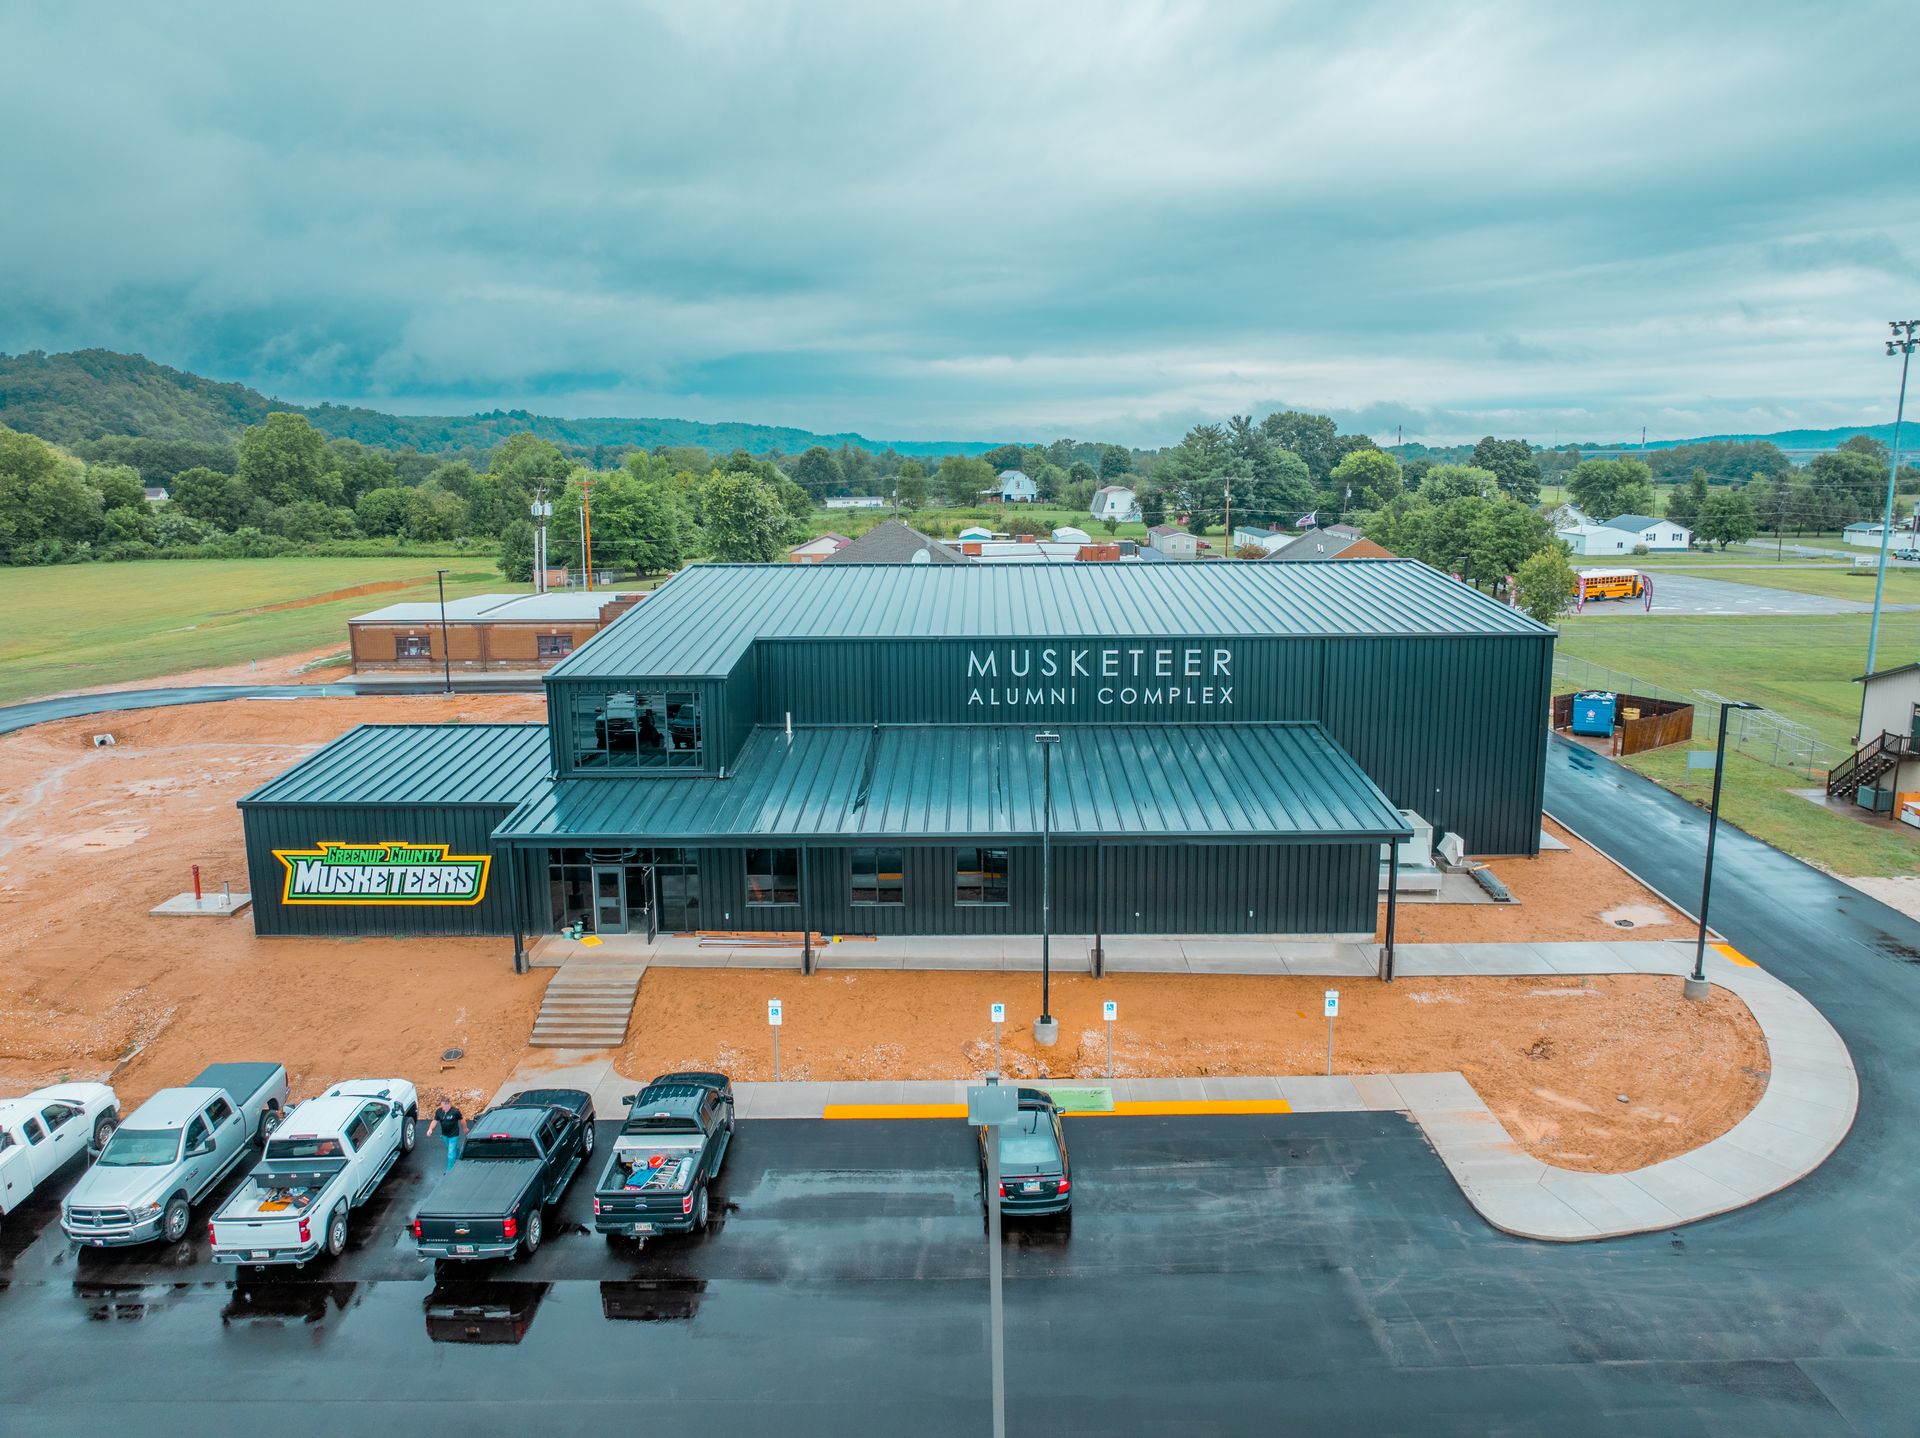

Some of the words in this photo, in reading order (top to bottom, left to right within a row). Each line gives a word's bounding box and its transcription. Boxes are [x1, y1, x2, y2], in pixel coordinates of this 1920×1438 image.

[967, 648, 1232, 677] MUSKETEER
[968, 687, 1076, 706] ALUMNI
[1097, 687, 1234, 705] COMPLEX
[327, 847, 386, 863] GREENUP
[389, 846, 441, 862] COUNTY
[294, 860, 477, 894] MUSKETEERS
